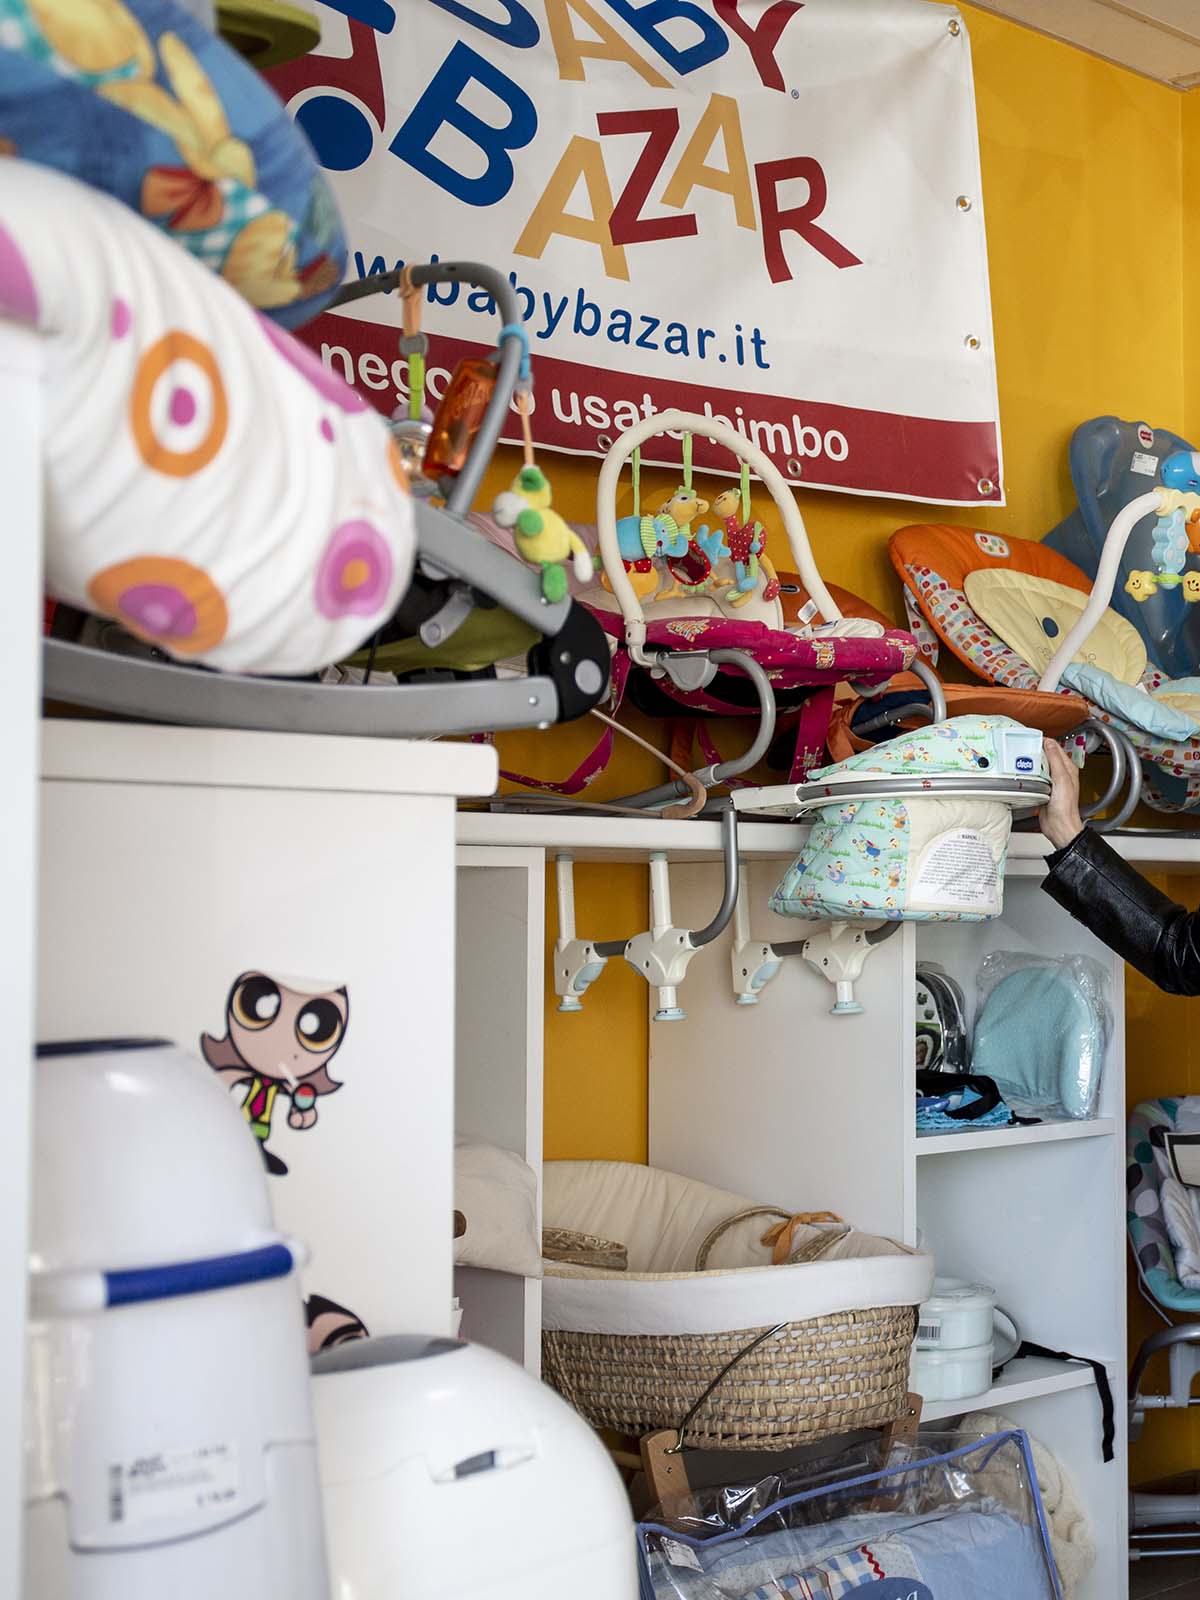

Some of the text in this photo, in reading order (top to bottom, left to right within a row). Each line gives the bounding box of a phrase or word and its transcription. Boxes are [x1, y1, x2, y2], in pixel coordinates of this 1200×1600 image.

[387, 40, 863, 284] BAZAR
[346, 250, 770, 370] wbabybazar.it
[321, 342, 536, 416] nego
